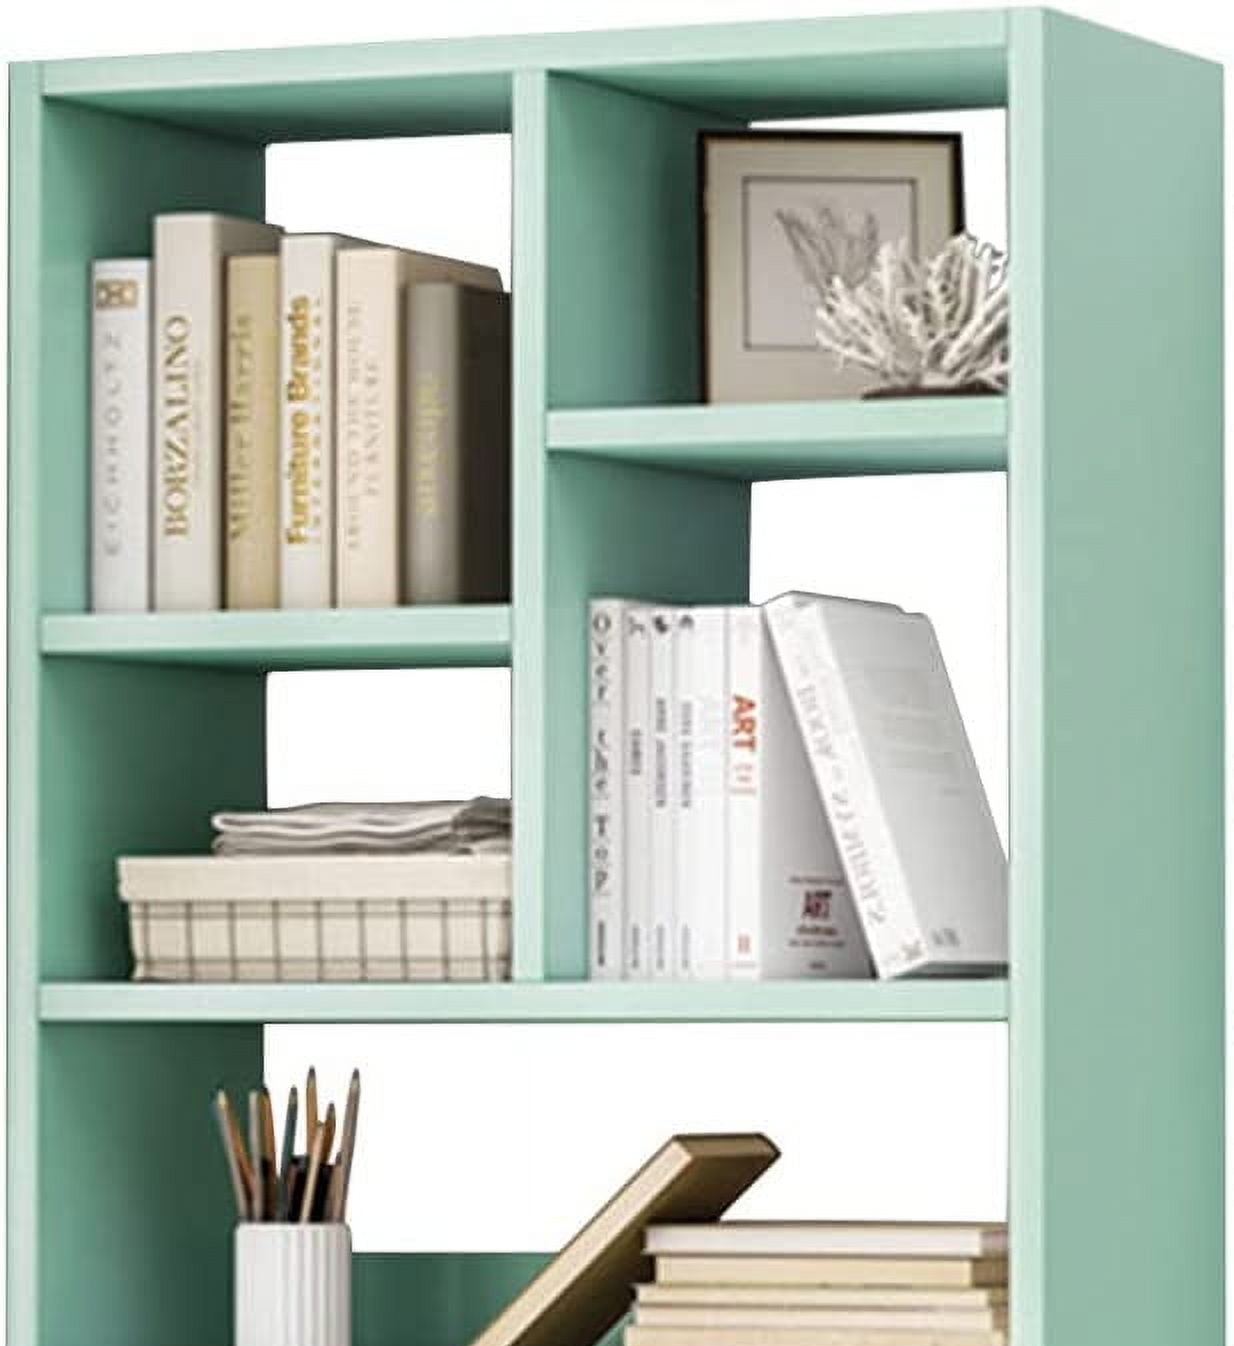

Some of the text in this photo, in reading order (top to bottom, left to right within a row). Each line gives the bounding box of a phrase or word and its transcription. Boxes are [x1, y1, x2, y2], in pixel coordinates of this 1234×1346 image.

[103, 331, 124, 555] EICHHOLTZ
[163, 315, 191, 538] BORZALINO
[286, 294, 310, 545] Furniture Brands
[733, 694, 757, 751] ART
